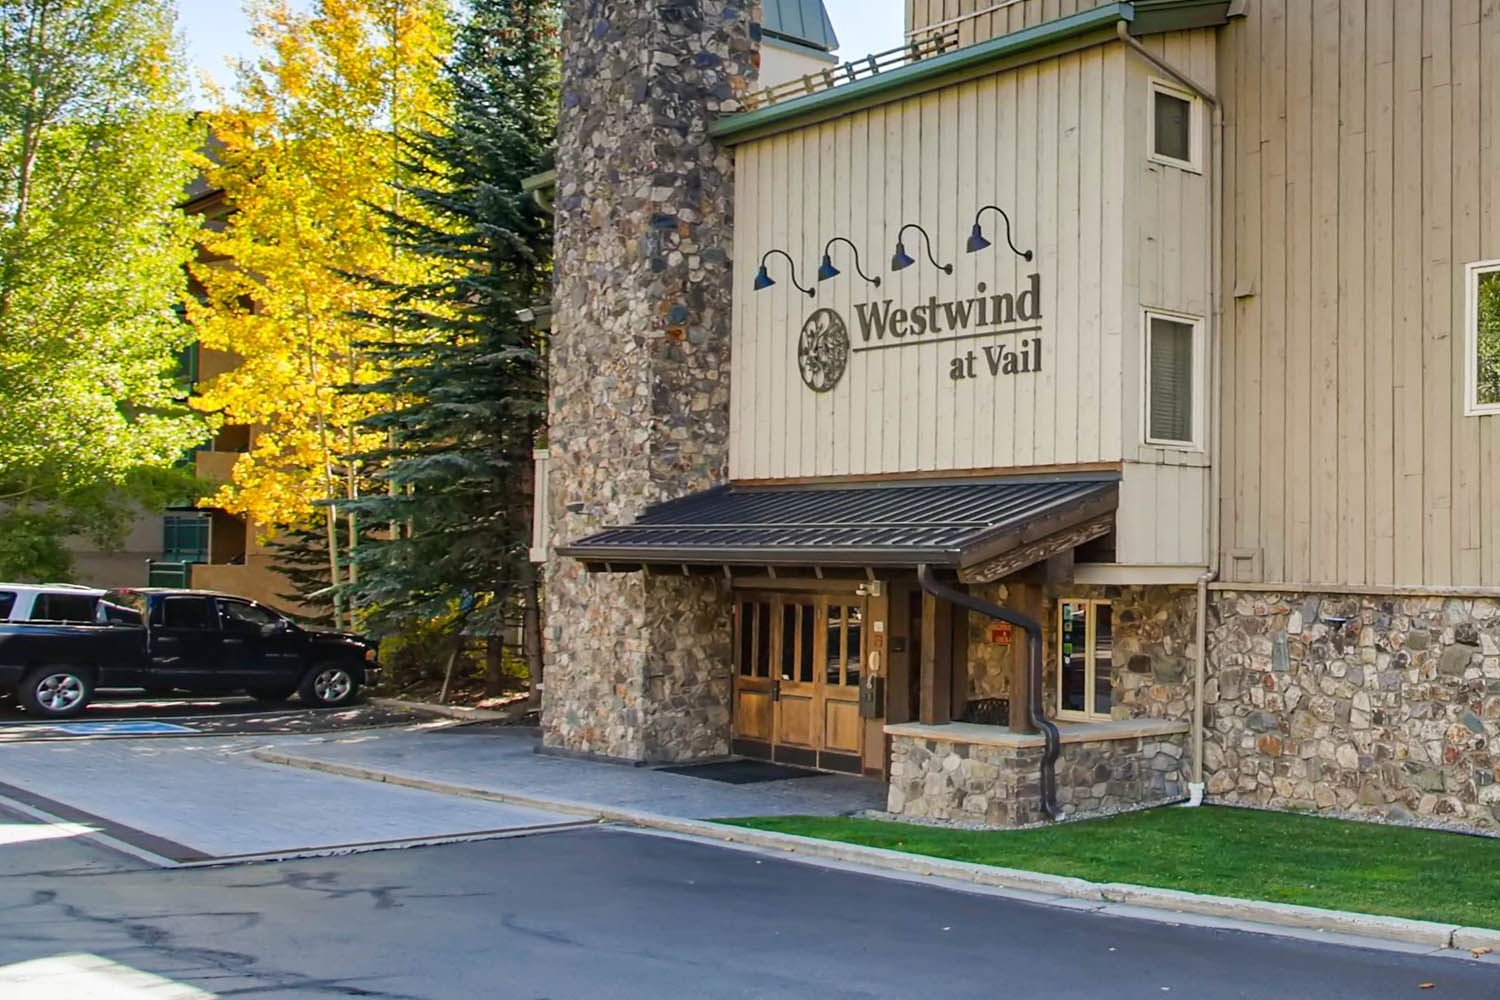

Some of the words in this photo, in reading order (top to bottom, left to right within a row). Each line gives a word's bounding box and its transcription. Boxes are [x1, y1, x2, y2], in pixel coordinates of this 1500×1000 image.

[853, 273, 1043, 342] Westwind
[949, 350, 977, 382] at
[981, 338, 1043, 377] Vail
